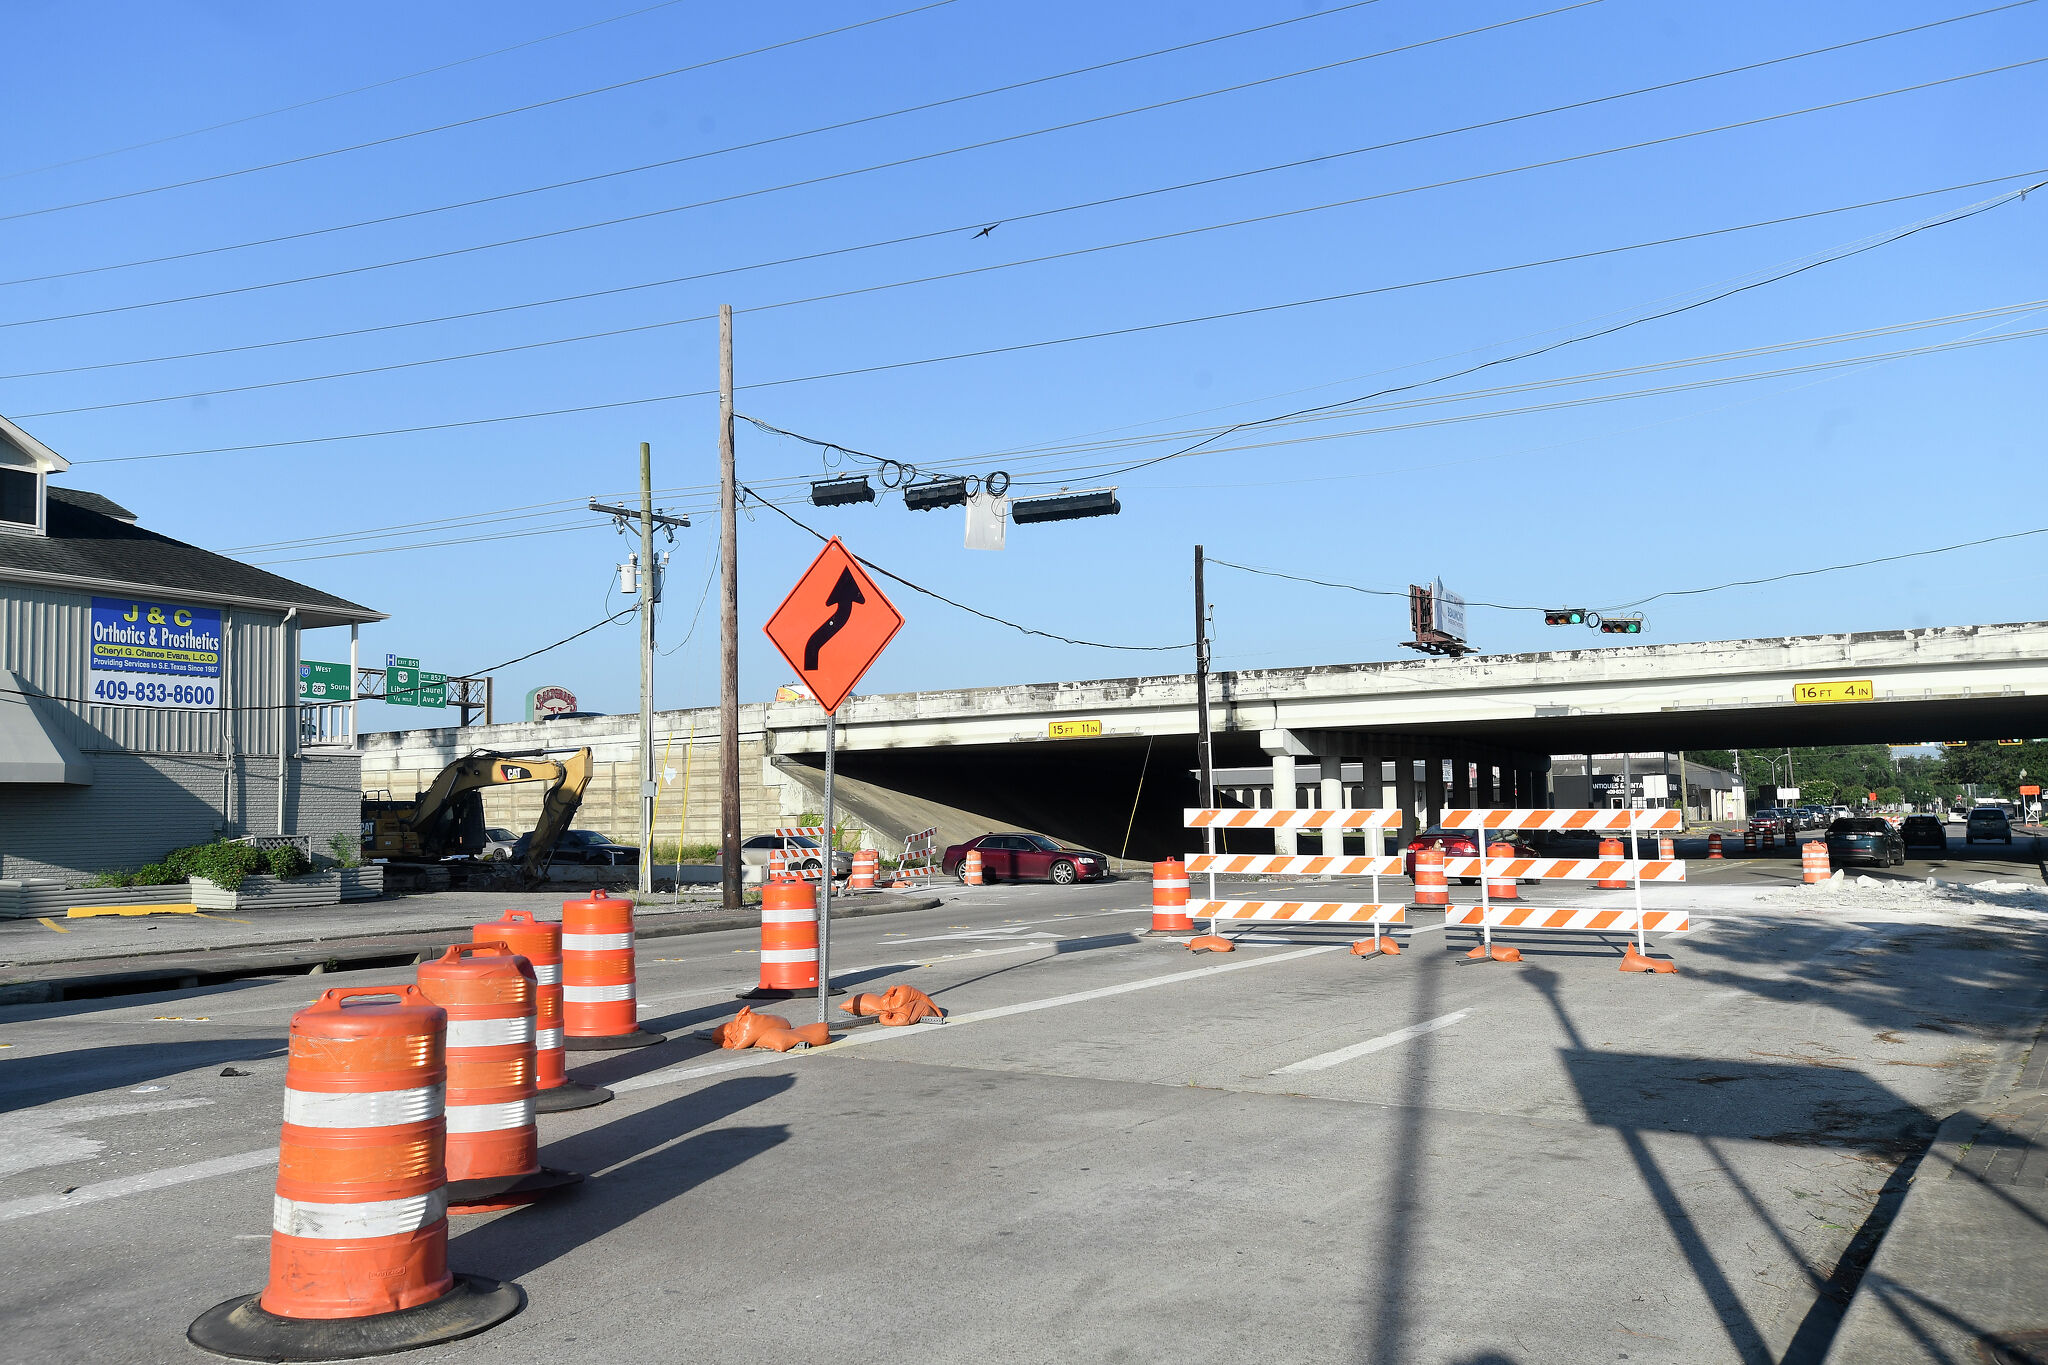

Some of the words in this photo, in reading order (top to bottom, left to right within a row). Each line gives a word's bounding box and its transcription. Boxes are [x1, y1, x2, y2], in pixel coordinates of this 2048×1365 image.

[123, 604, 139, 622] J
[147, 606, 166, 625] &
[173, 609, 192, 627] C
[93, 621, 146, 645] Orthotics
[148, 626, 158, 646] &
[161, 627, 219, 651] Prosthetics
[97, 645, 123, 656] Cheryl
[125, 648, 135, 656] G.
[135, 649, 165, 658] Chance
[166, 651, 191, 661] Evans,
[192, 653, 216, 663] L.C.O.
[387, 654, 395, 666] H
[93, 658, 122, 668] Providing
[124, 660, 150, 669] Services
[151, 661, 157, 669] to
[170, 663, 187, 671] Texas
[187, 664, 204, 672] Since
[315, 665, 332, 673] WEST
[408, 659, 418, 667] 851
[94, 679, 215, 705] 409-833-8600
[330, 683, 350, 691] SOUTH
[422, 687, 443, 695] Laurel
[1801, 687, 1817, 698] 16
[1819, 689, 1832, 697] FT
[1844, 685, 1855, 696] 4
[1858, 688, 1868, 696] IN
[422, 696, 435, 704] Ave
[1053, 725, 1064, 734] 15
[1082, 724, 1089, 733] 11
[507, 767, 522, 780] CAT
[360, 822, 374, 836] CAT
